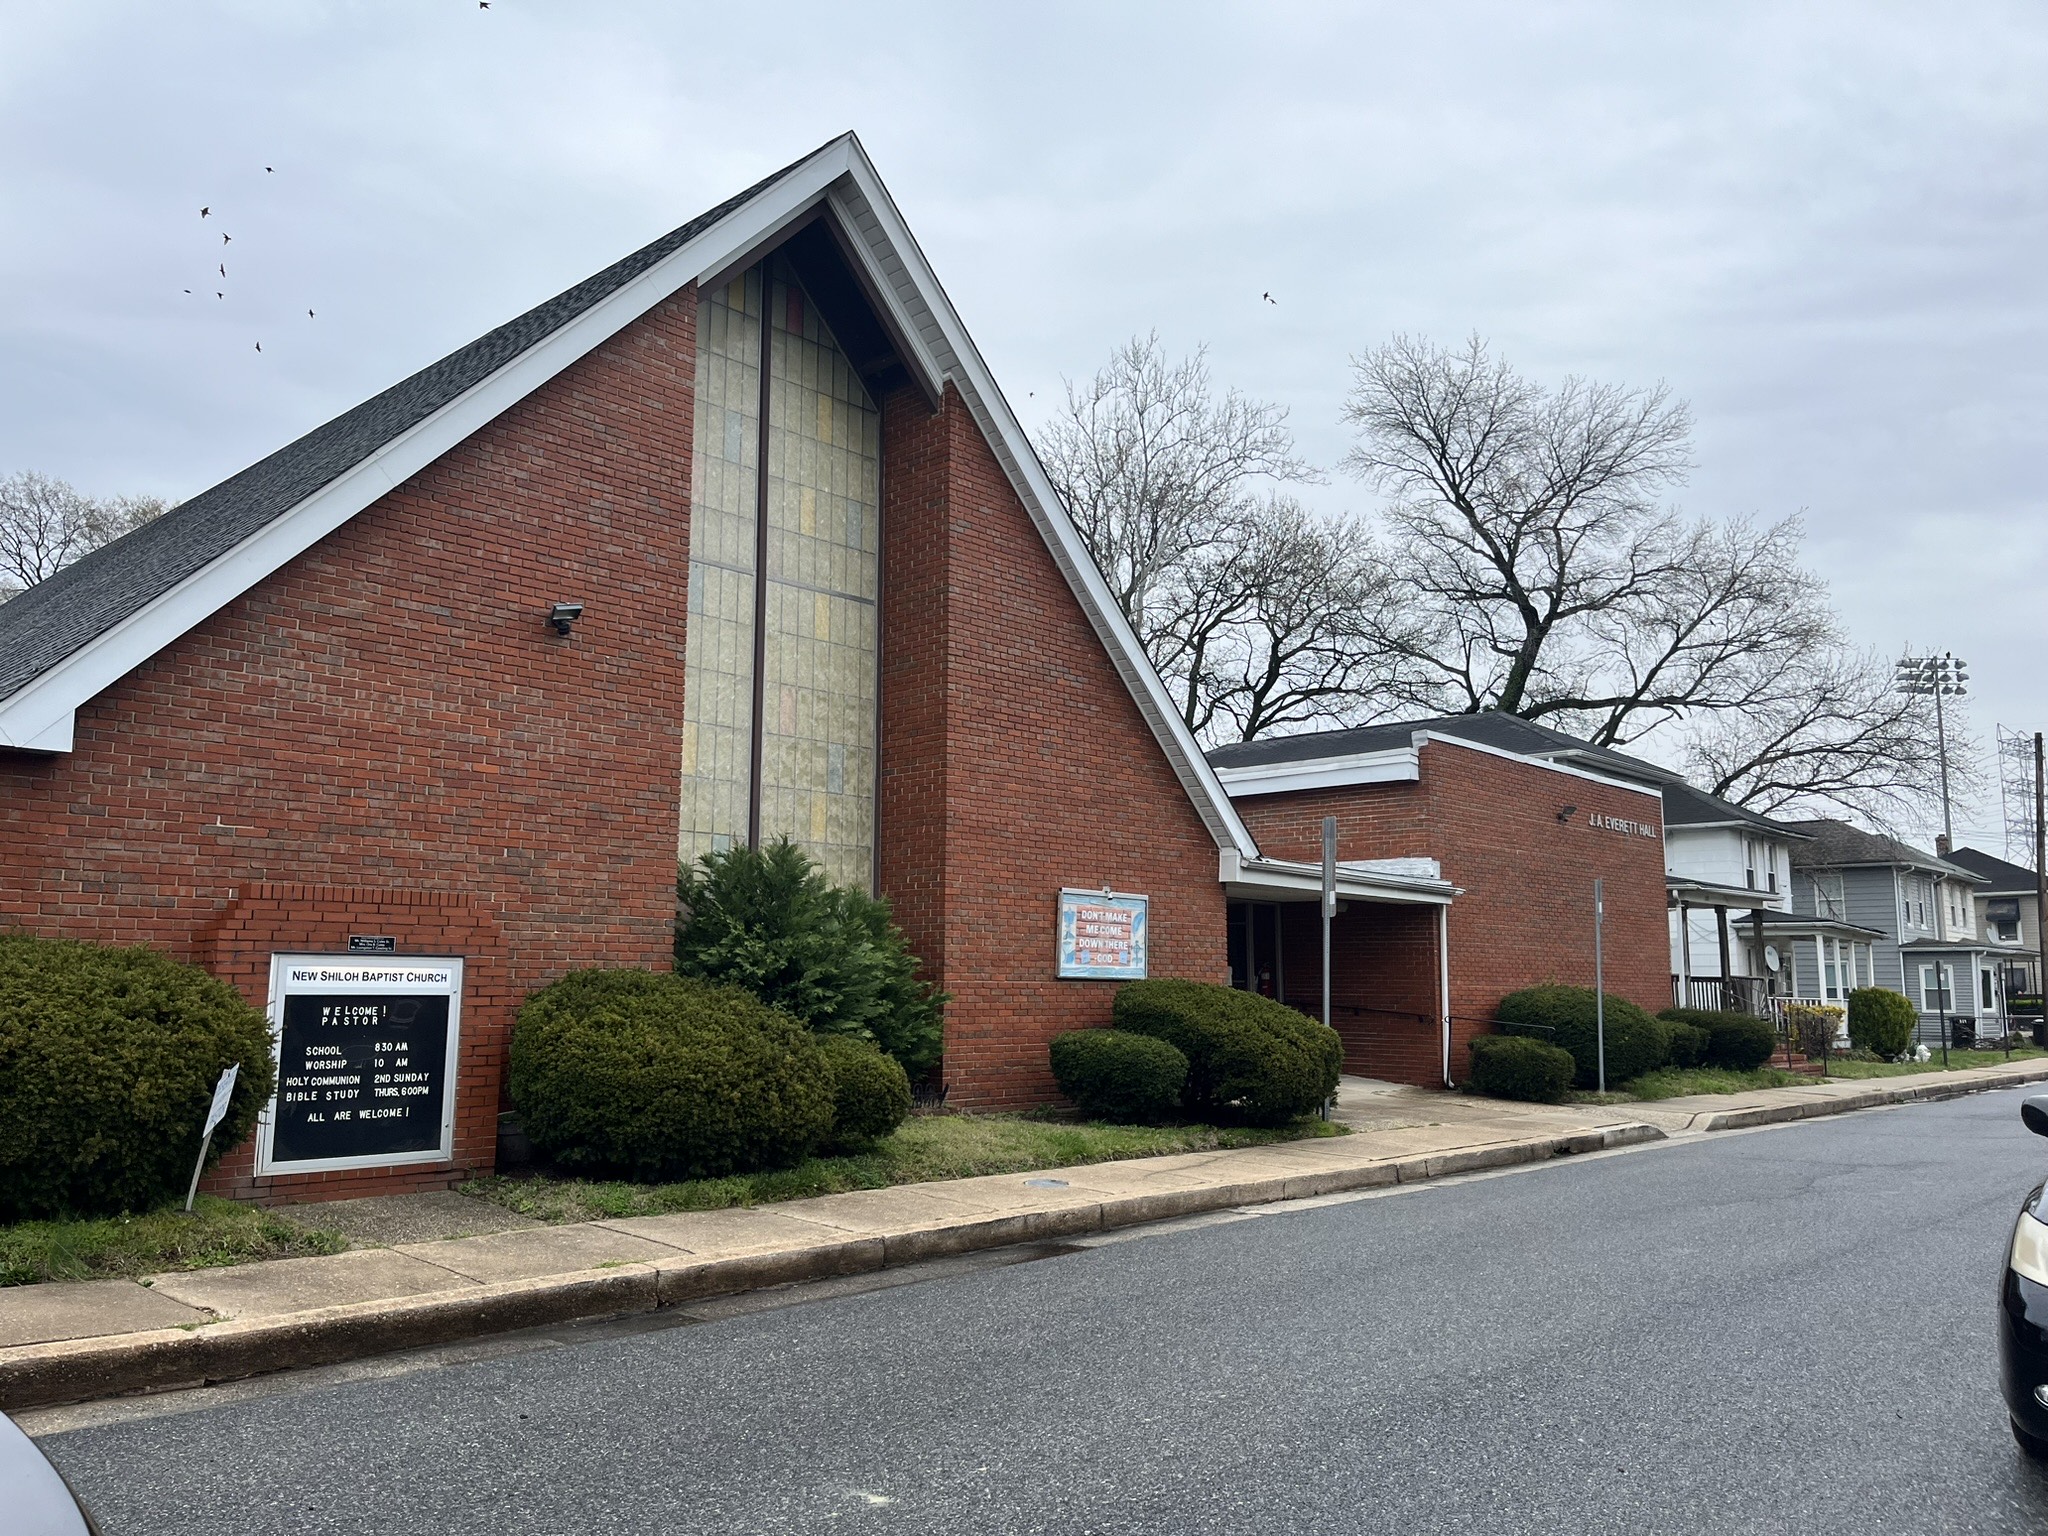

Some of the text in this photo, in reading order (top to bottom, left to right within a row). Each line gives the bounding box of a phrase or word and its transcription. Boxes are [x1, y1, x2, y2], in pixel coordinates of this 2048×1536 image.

[1605, 816, 1637, 834] EVERETT
[1639, 823, 1656, 838] HALL
[1106, 912, 1127, 922] MAKE
[1086, 924, 1122, 936] ME COME
[1079, 939, 1128, 950] DOWN THERE
[292, 971, 447, 983] NEW SHILOH BAPTIST CHURCH
[321, 1016, 378, 1026] PASTOR
[305, 1046, 342, 1056] SCHOOL
[395, 1042, 408, 1051] AM
[305, 1058, 408, 1070] WORSHIP 10 AM
[286, 1073, 429, 1086] HOLY COMMUNION 2ND SUNDAY
[286, 1091, 318, 1102] BIBLE
[326, 1089, 360, 1101] STUDY
[307, 1113, 325, 1122] ALL
[334, 1110, 352, 1120] ARE
